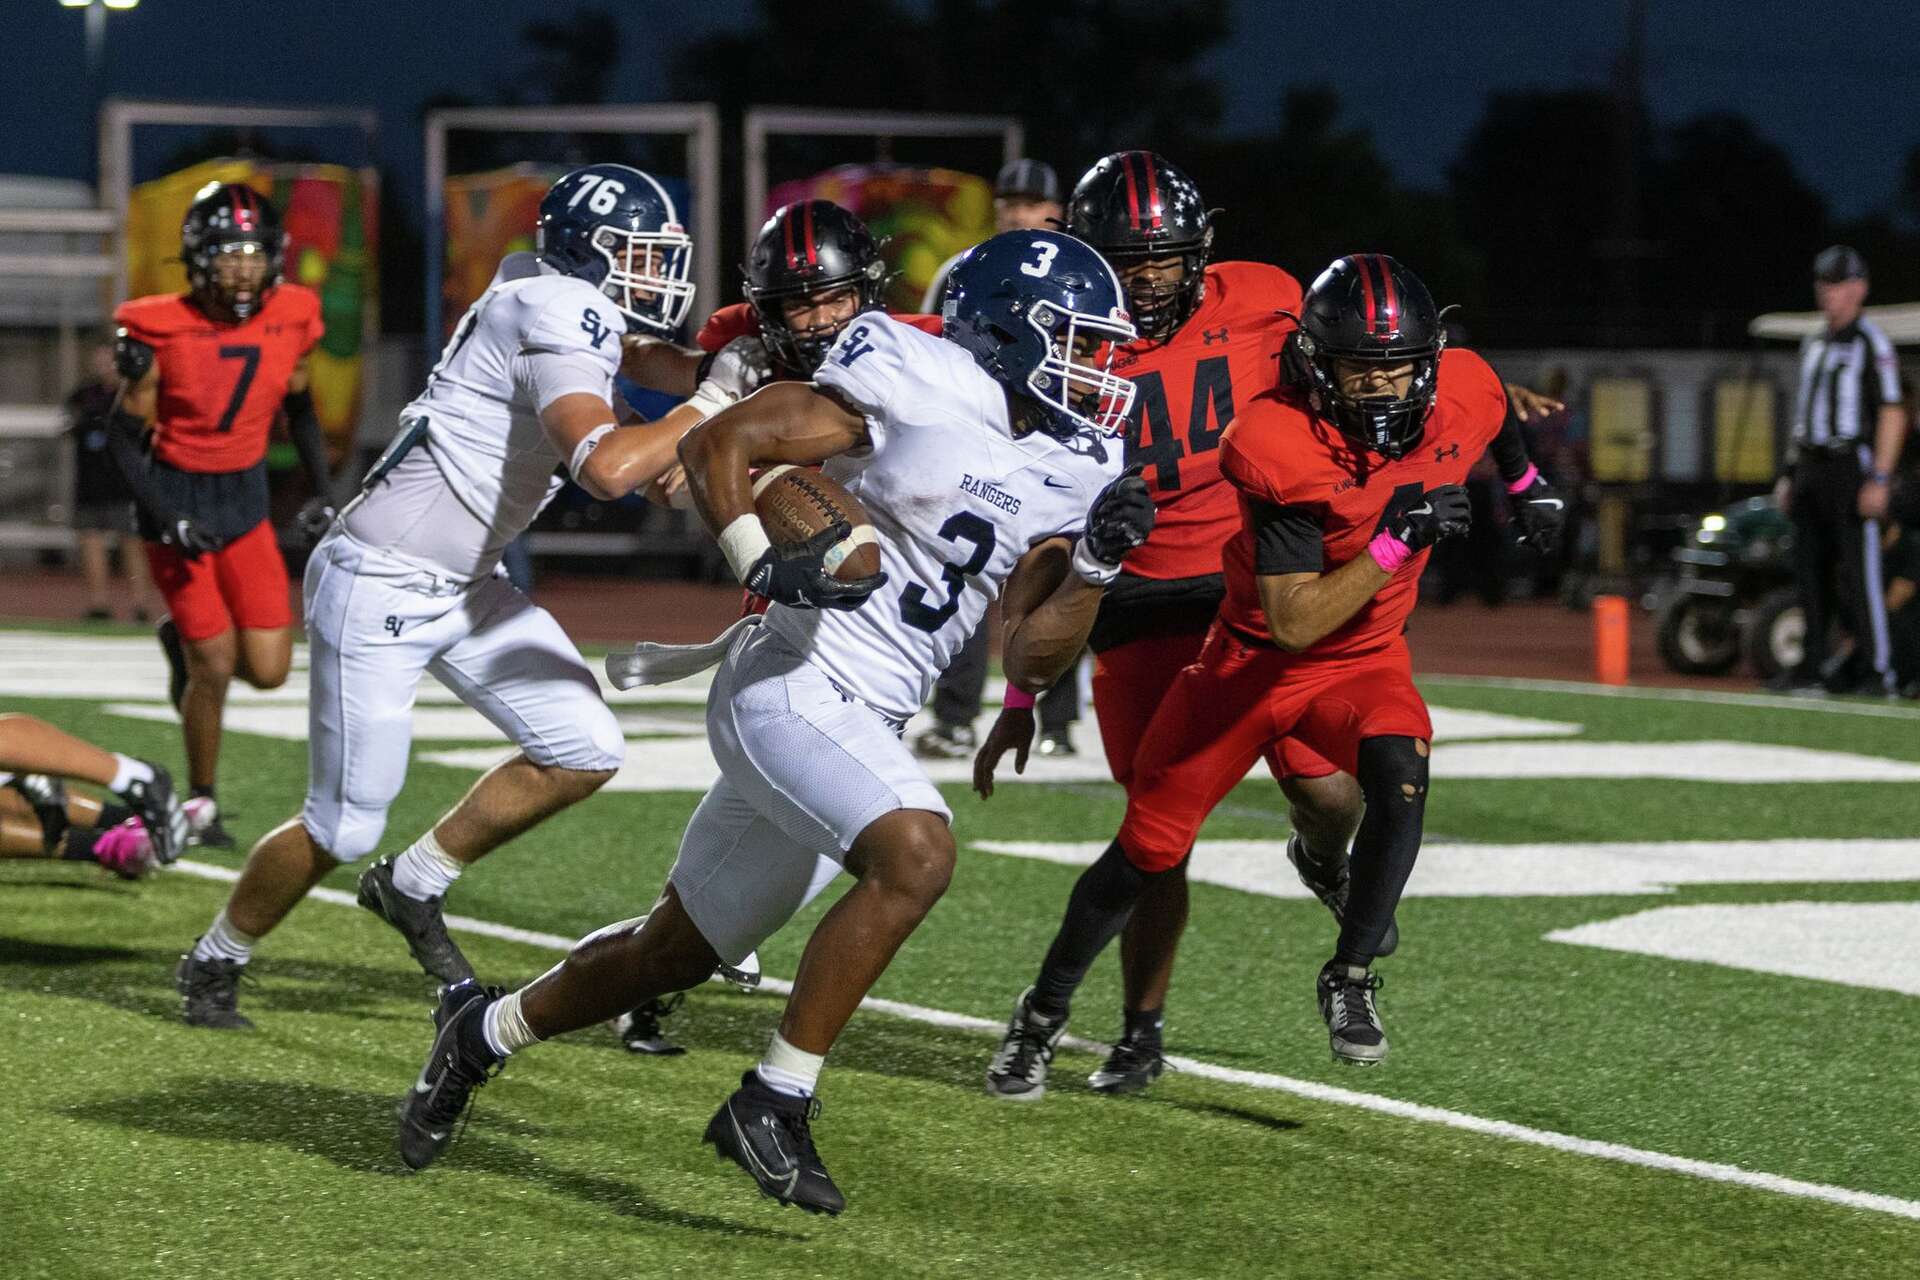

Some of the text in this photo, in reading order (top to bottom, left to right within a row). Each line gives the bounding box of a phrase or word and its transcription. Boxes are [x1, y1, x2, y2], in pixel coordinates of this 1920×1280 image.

[567, 174, 626, 215] 76
[1020, 241, 1059, 278] 3
[580, 307, 611, 349] SV
[839, 325, 876, 368] SV
[219, 346, 261, 432] 7
[1126, 355, 1235, 491] 44
[771, 493, 815, 537] Wilson
[959, 473, 1022, 515] RANGERS
[899, 510, 996, 633] 3
[384, 616, 404, 637] SV
